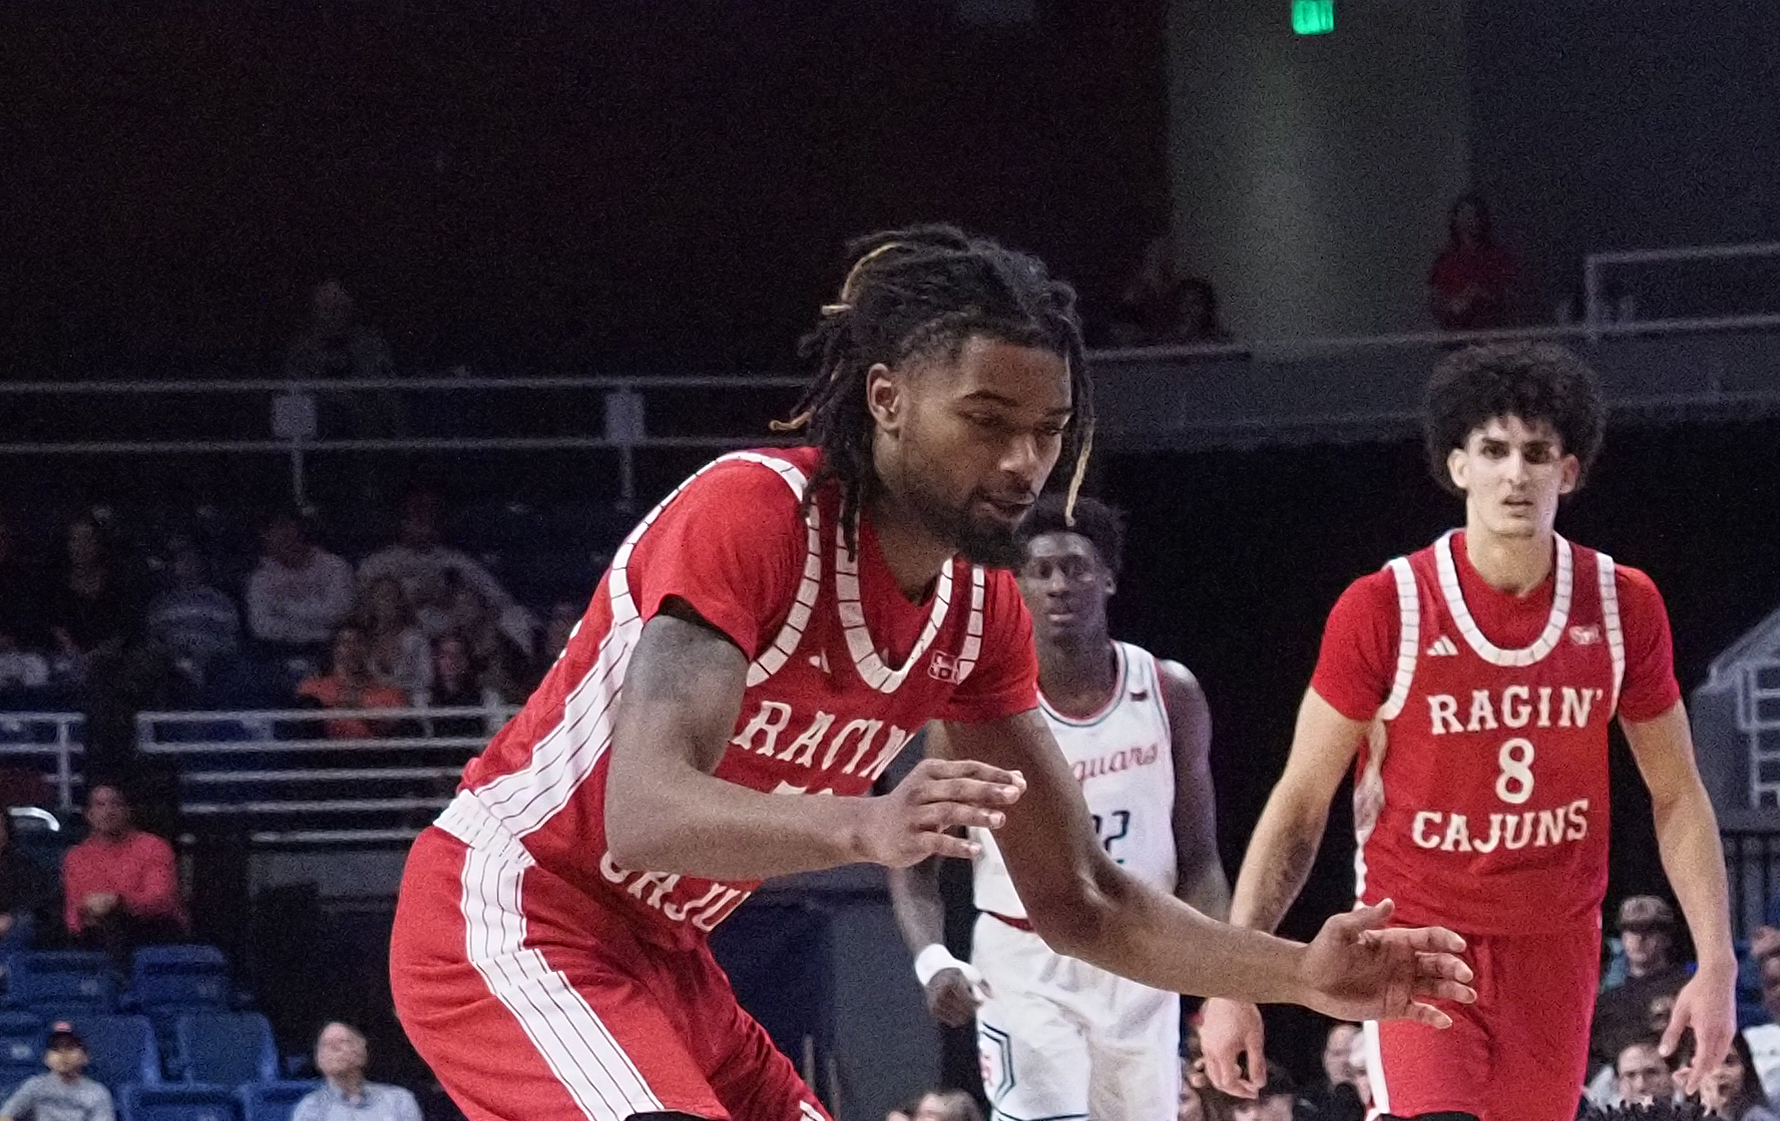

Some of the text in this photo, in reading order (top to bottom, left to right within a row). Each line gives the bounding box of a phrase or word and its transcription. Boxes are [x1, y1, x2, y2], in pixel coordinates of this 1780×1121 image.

[1426, 684, 1604, 735] RAGIN'
[1494, 737, 1536, 804] 8
[1411, 797, 1590, 854] CAJUNS
